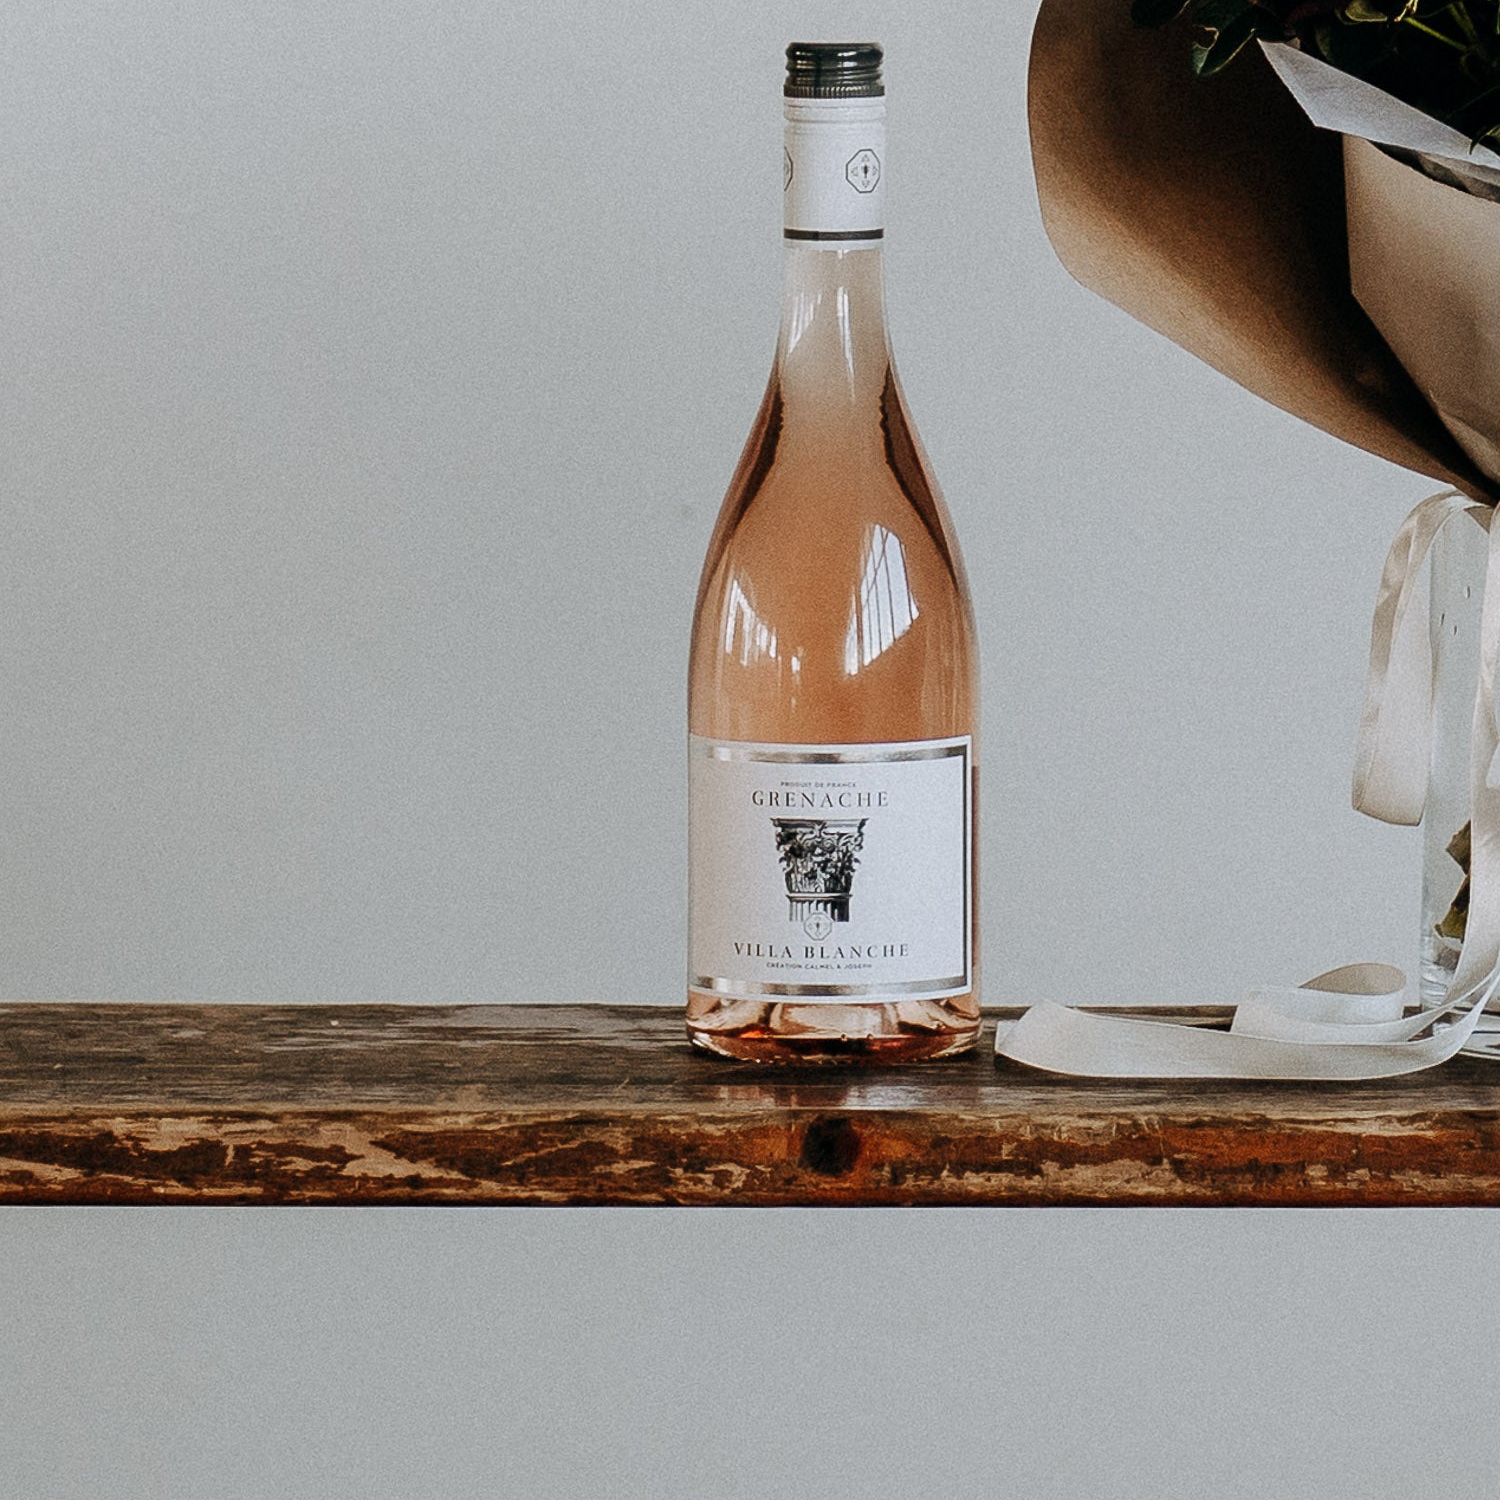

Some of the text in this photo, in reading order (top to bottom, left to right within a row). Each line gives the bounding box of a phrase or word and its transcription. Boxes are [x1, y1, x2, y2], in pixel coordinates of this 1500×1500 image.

[752, 790, 889, 808] GRENACHE
[734, 942, 910, 959] VILLA BLANCHE
